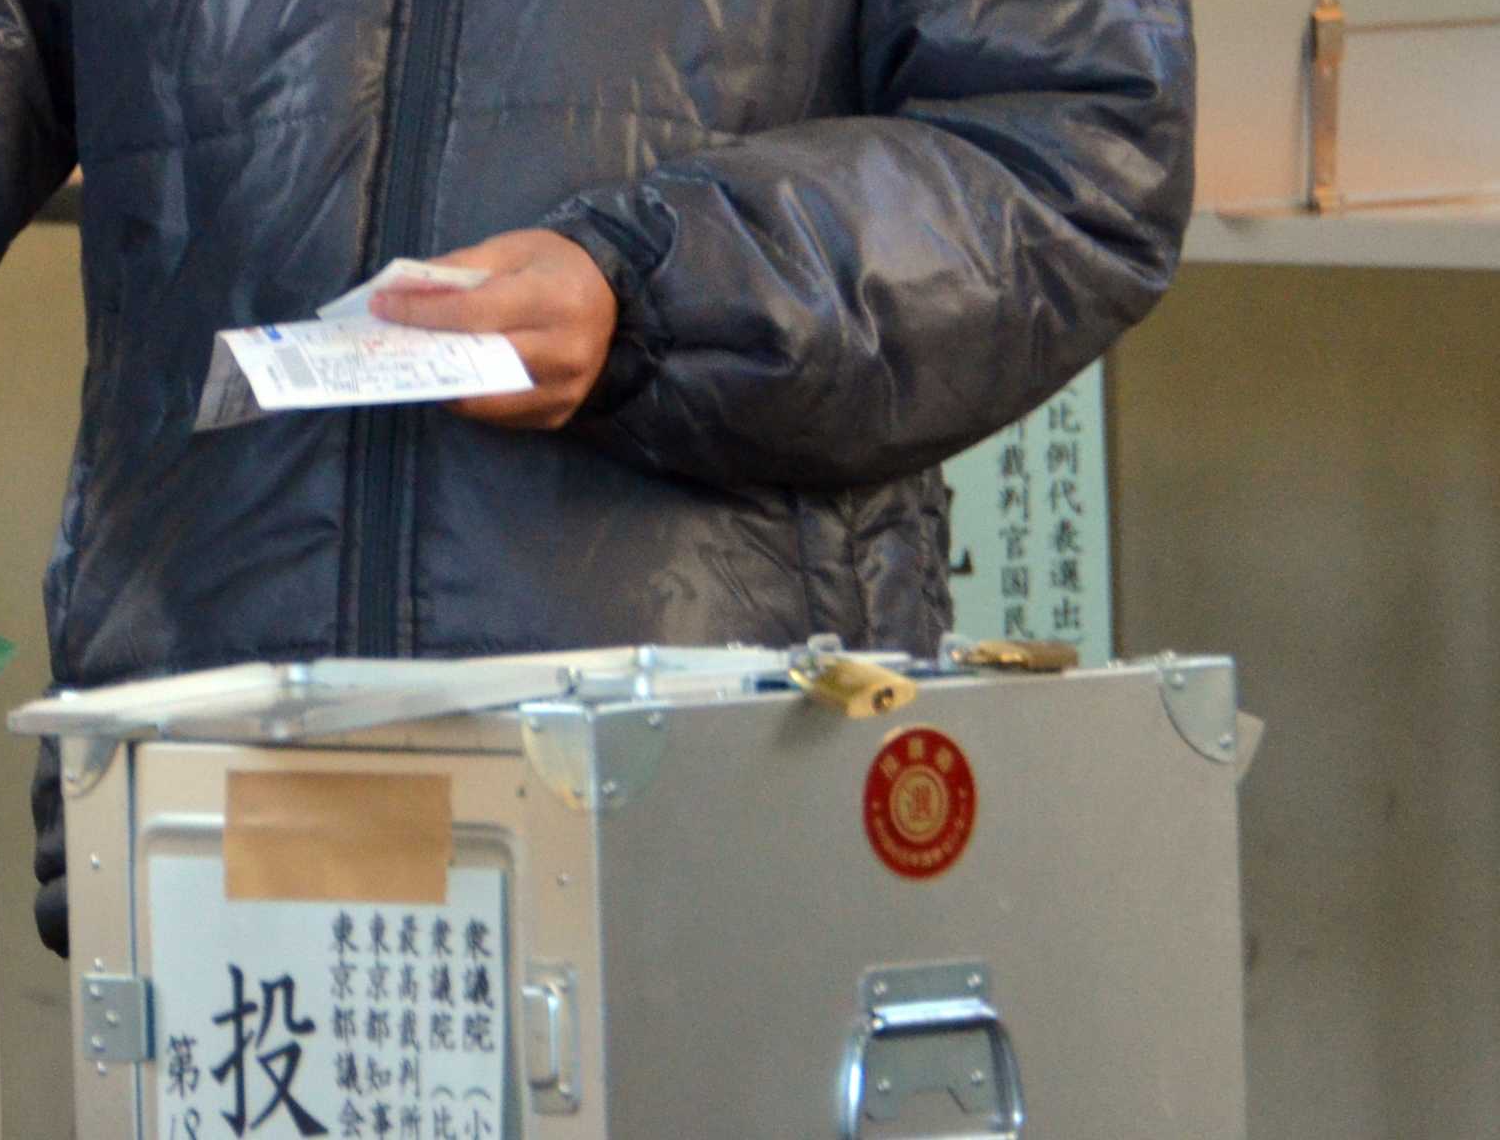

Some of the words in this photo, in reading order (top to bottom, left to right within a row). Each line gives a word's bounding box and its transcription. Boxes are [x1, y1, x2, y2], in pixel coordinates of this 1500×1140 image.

[211, 963, 329, 1139] 投
[329, 910, 364, 1140] 東京都議会
[365, 911, 393, 1140] 東京都知事
